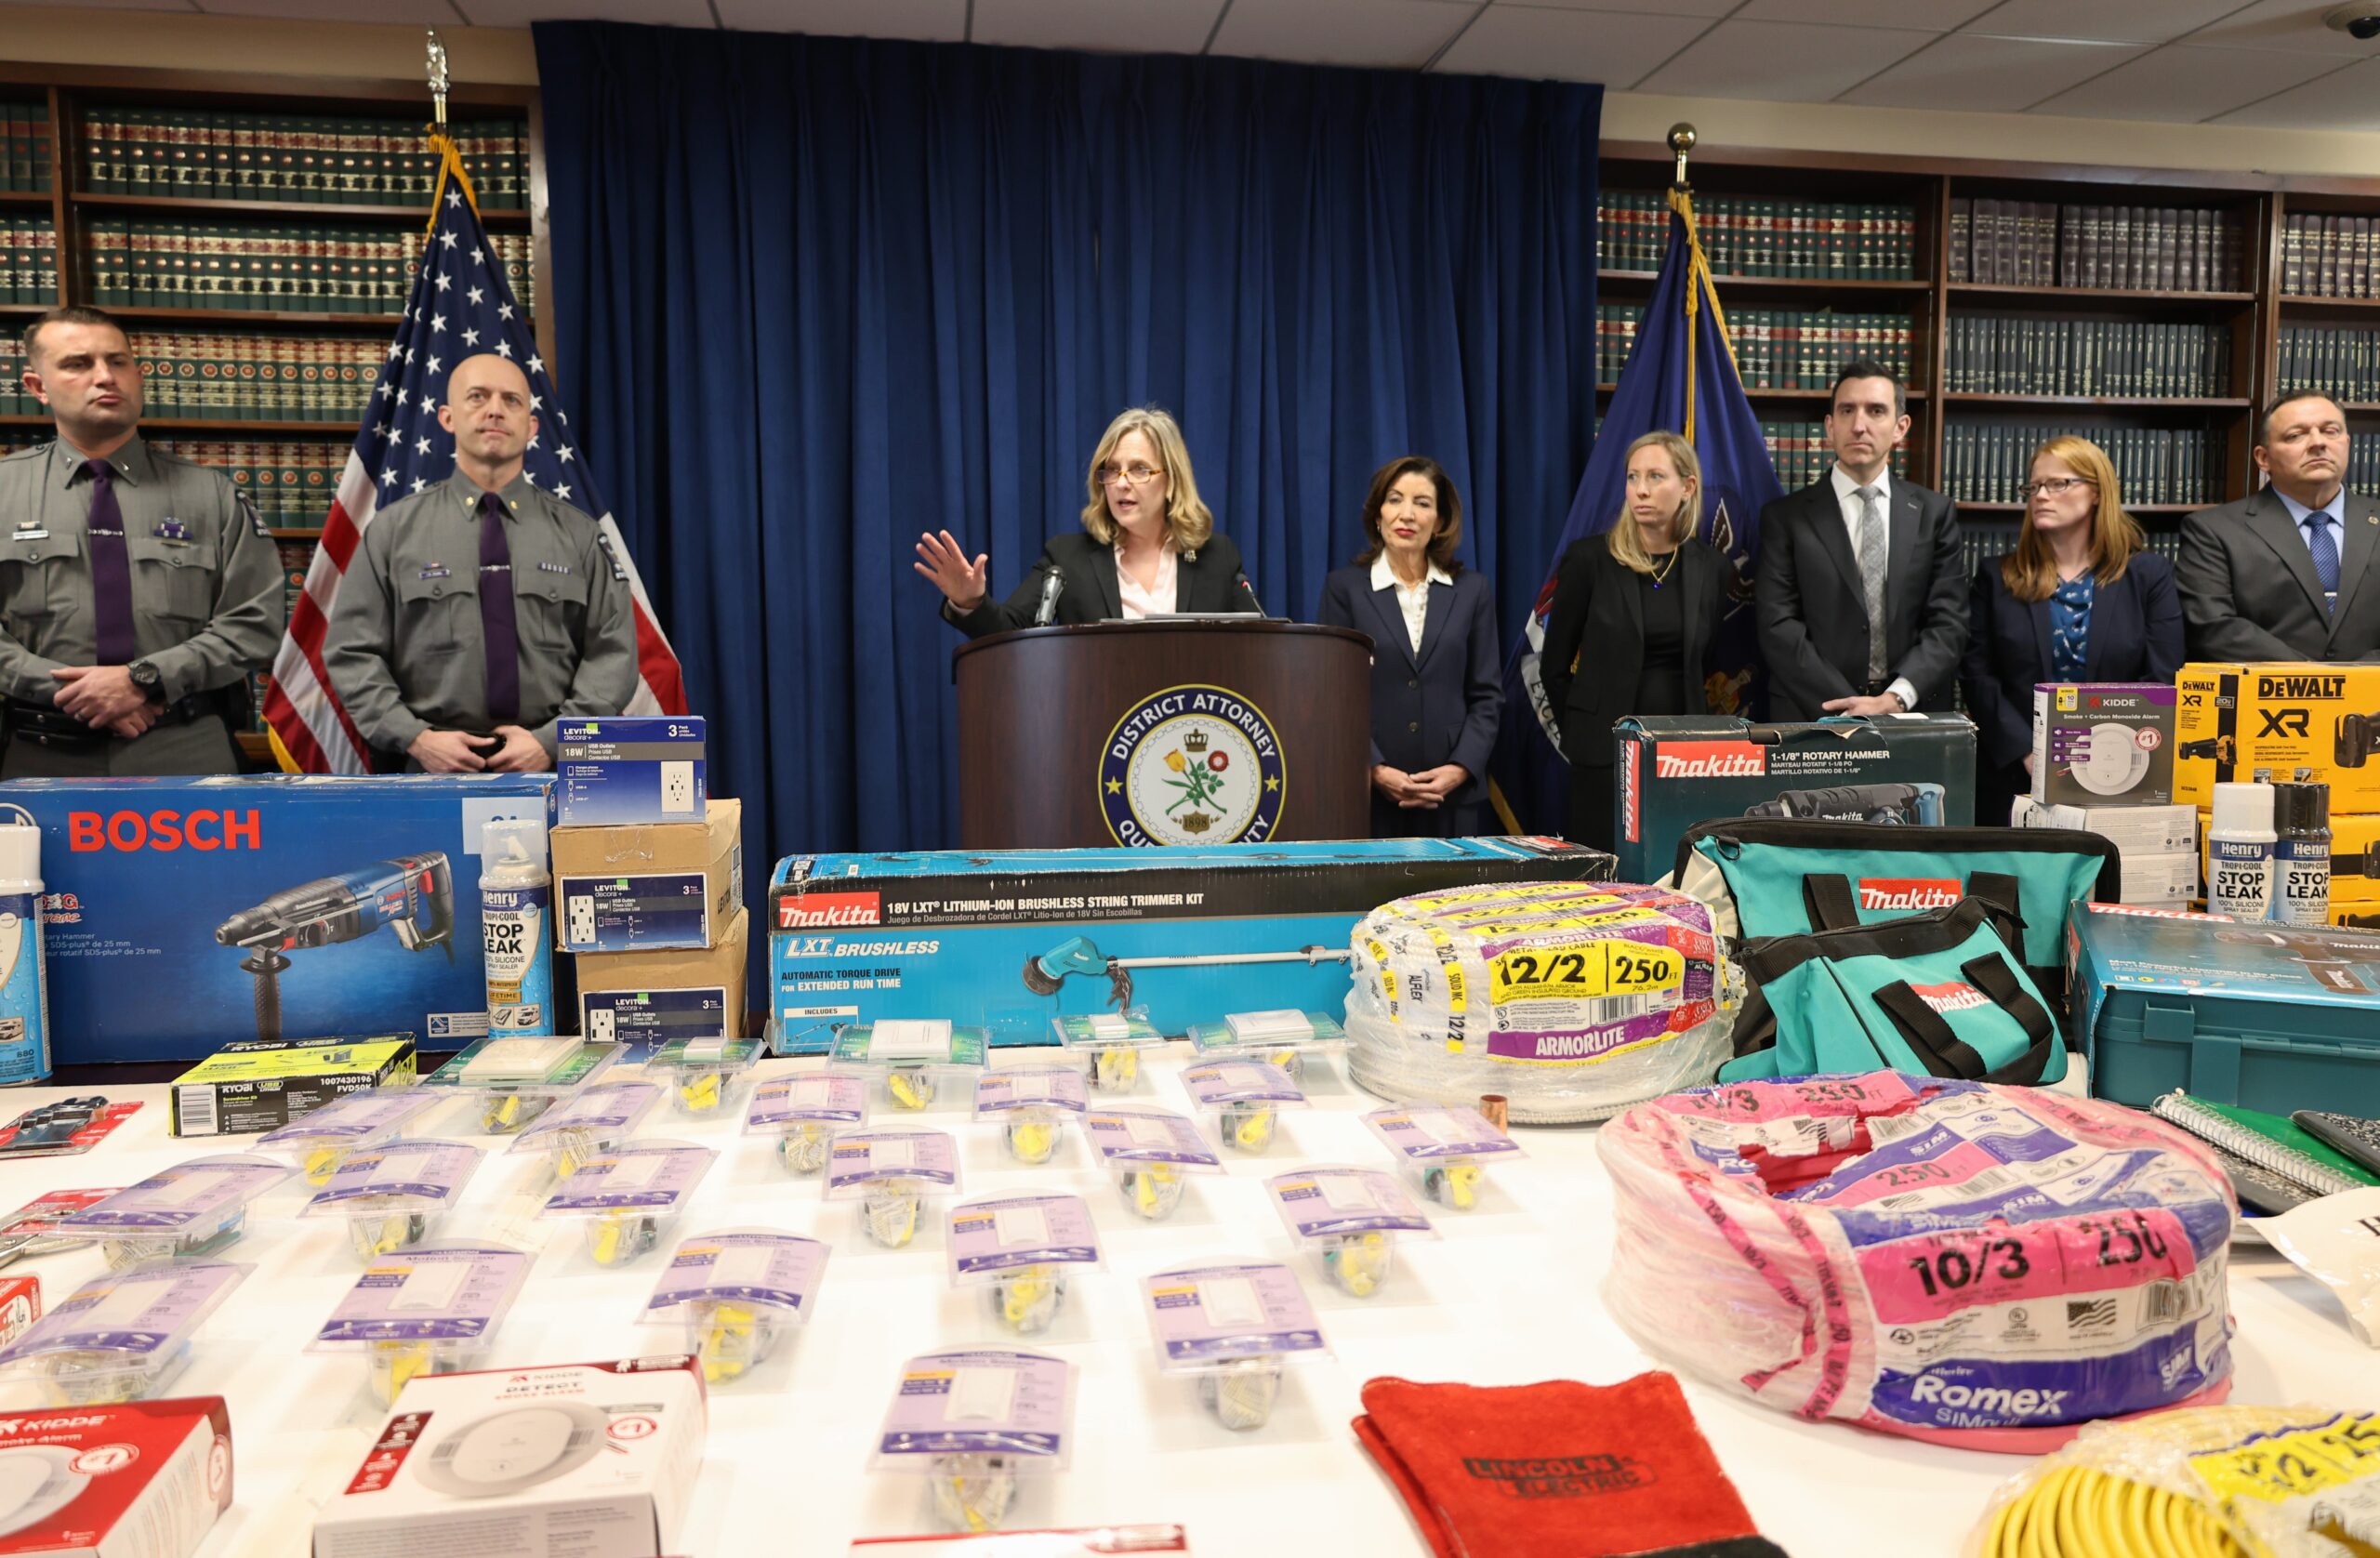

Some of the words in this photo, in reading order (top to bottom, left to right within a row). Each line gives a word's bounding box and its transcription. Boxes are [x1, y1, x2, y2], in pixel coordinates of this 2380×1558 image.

[2182, 694, 2202, 706] XR
[1112, 694, 1185, 760] DISTRICT
[1193, 693, 1276, 759] ATTORNEY
[2256, 709, 2310, 737] XR
[668, 725, 678, 737] 3
[1771, 752, 1800, 760] 1-1/8"
[1803, 751, 1843, 760] ROTARY
[1844, 750, 1890, 759] HAMMER
[1184, 816, 1207, 827] 1898
[68, 809, 260, 852] BOSCH
[2221, 843, 2262, 857] Henry
[2294, 843, 2329, 857] Henry
[2218, 871, 2265, 885] STOP
[2289, 872, 2328, 885] STOP
[682, 886, 690, 895] 3
[2216, 885, 2263, 899] LEAK
[2287, 885, 2328, 899] LEAK
[483, 891, 518, 908] Henry
[887, 902, 909, 914] 18V
[944, 898, 1014, 912] LITHIUM-ION
[1018, 897, 1084, 910] BRUSHLESS
[1088, 895, 1128, 907] STRING
[1130, 894, 1183, 906] TRIMMER
[1185, 893, 1204, 904] KIT
[887, 916, 911, 924] Juego
[923, 914, 975, 922] Desbrozadora
[987, 911, 1012, 920] Cordel
[1077, 909, 1090, 918] 18V
[1091, 908, 1104, 917] Sin
[1105, 908, 1143, 917] Escobillas
[483, 924, 523, 939] STOP
[1522, 930, 1624, 946] ARMORLITE
[785, 936, 835, 958] LXT
[834, 941, 940, 957] BRUSHLESS
[1569, 943, 1596, 951] CABLE
[781, 970, 834, 981] AUTOMATIC
[836, 969, 872, 979] TORQUE
[874, 968, 901, 976] DRIVE
[1501, 953, 1586, 986] 12/2
[1615, 958, 1669, 984] 250
[1669, 971, 1677, 981] FT
[798, 980, 850, 991] EXTENDED
[853, 979, 873, 989] RUN
[877, 978, 901, 988] TIME
[1408, 974, 1423, 1002] ALFLEX
[1448, 972, 1461, 990] SOLID
[1450, 990, 1462, 1001] MC
[703, 999, 709, 1010] 3
[1448, 1014, 1466, 1041] 12/2
[1536, 1025, 1625, 1057] ARMORLITE
[320, 1075, 372, 1086] 1007430196
[222, 1083, 253, 1093] RYOBI
[337, 1084, 372, 1093] FVD50K
[1795, 1084, 1867, 1102] 250
[1910, 1129, 1951, 1156] SIM
[1876, 1161, 1950, 1186] 250
[1910, 1238, 2030, 1297] 10/3
[506, 1381, 582, 1393] DETECT
[1911, 1374, 2069, 1416] Romex
[23, 1415, 107, 1432] KIDDE
[0, 1436, 35, 1447] moke
[1472, 1456, 1613, 1478] LINCOLN
